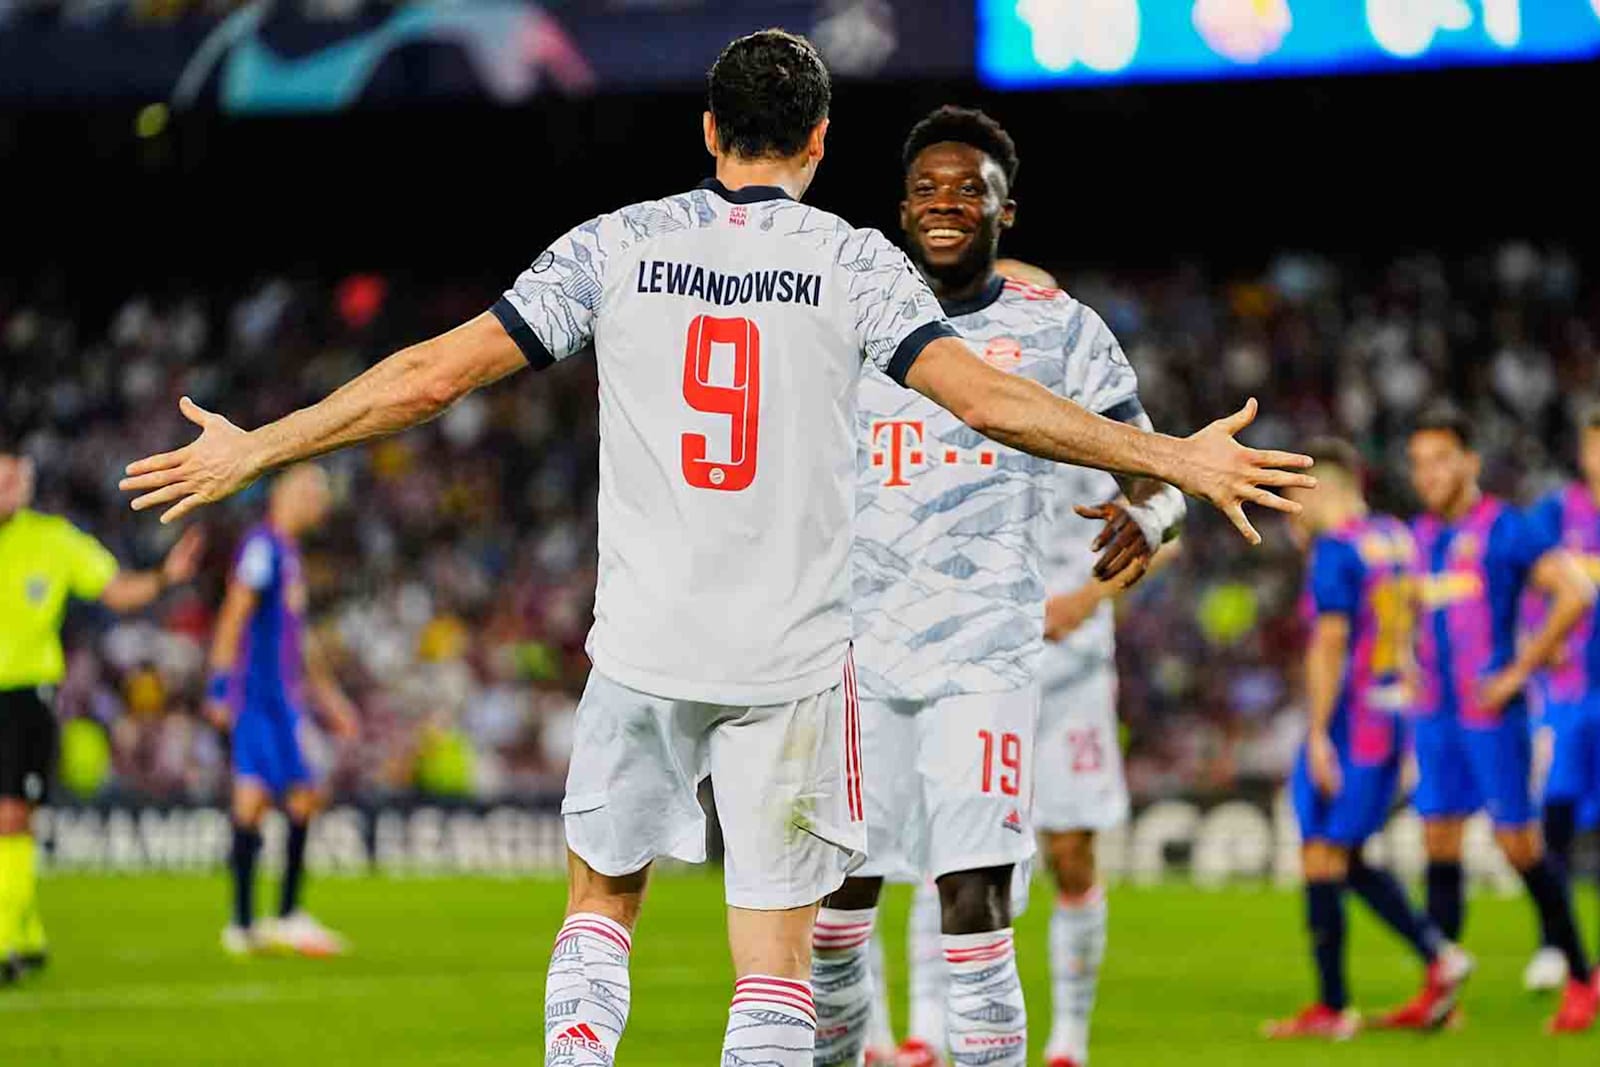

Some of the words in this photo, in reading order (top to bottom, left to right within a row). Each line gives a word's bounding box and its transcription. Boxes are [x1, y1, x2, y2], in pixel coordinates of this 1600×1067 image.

[637, 260, 822, 307] LEWANDOWSKI
[681, 314, 760, 491] 9
[872, 421, 924, 486] T
[978, 730, 1022, 797] 19
